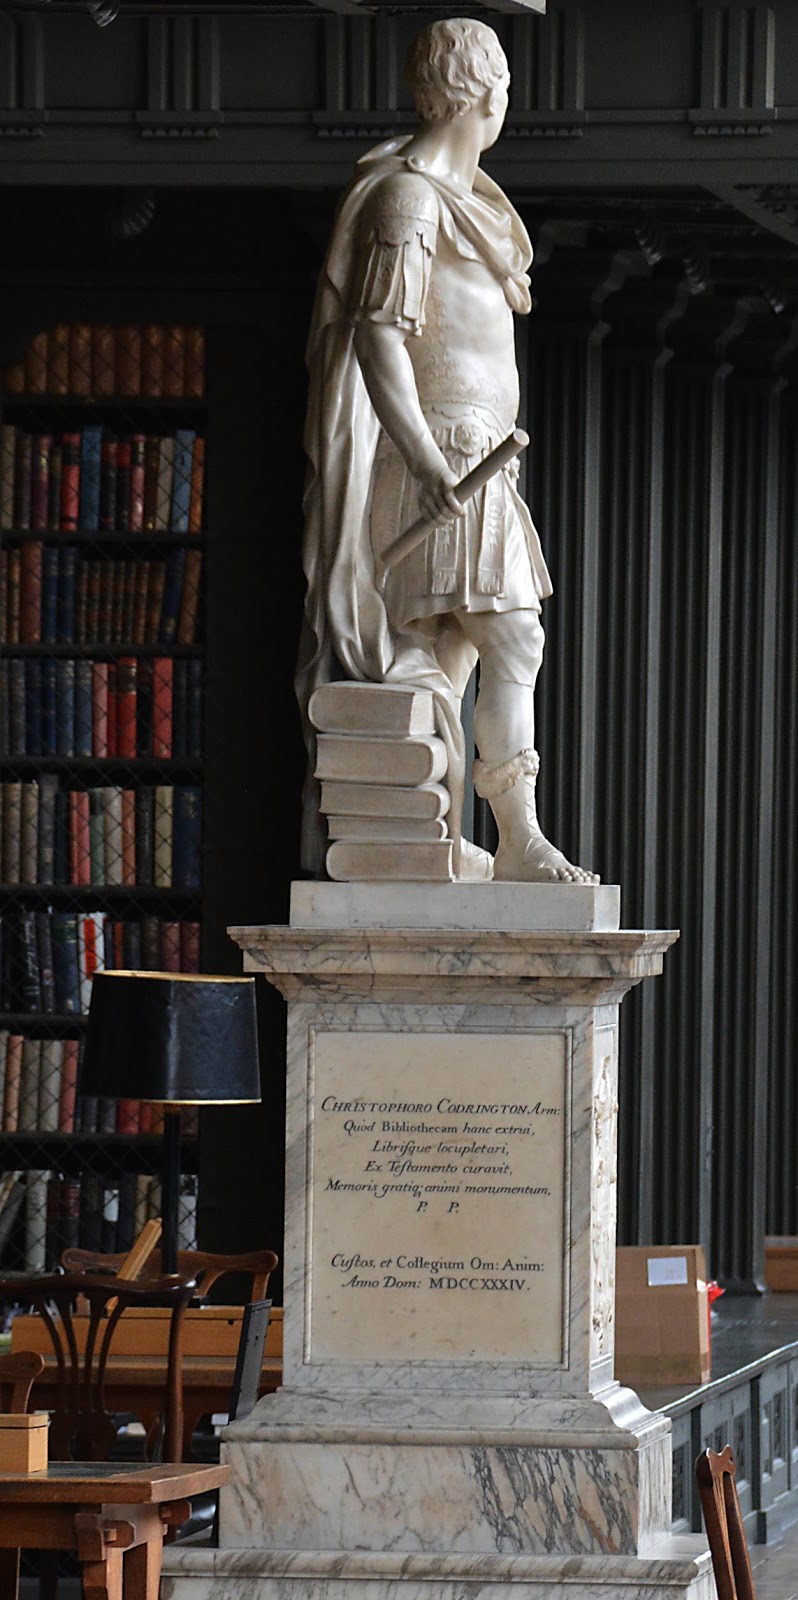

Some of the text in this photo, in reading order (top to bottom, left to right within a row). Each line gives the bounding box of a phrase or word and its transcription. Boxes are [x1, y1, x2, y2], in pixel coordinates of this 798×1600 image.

[382, 1121, 458, 1134] Bibliothecam
[462, 1122, 492, 1135] hanc
[436, 1142, 509, 1157] locupletari,
[364, 1160, 383, 1172] Ex
[462, 1162, 513, 1175] curavit,
[324, 1179, 377, 1193] Memoris
[424, 1181, 461, 1194] animi
[464, 1183, 552, 1196] monumentum,
[416, 1201, 459, 1213] P. P.
[380, 1258, 393, 1269] et
[396, 1256, 464, 1273] Collegium
[470, 1257, 500, 1271] Om:
[502, 1255, 545, 1272] Anim:
[341, 1275, 379, 1288] Anno
[383, 1276, 422, 1289] Dom:
